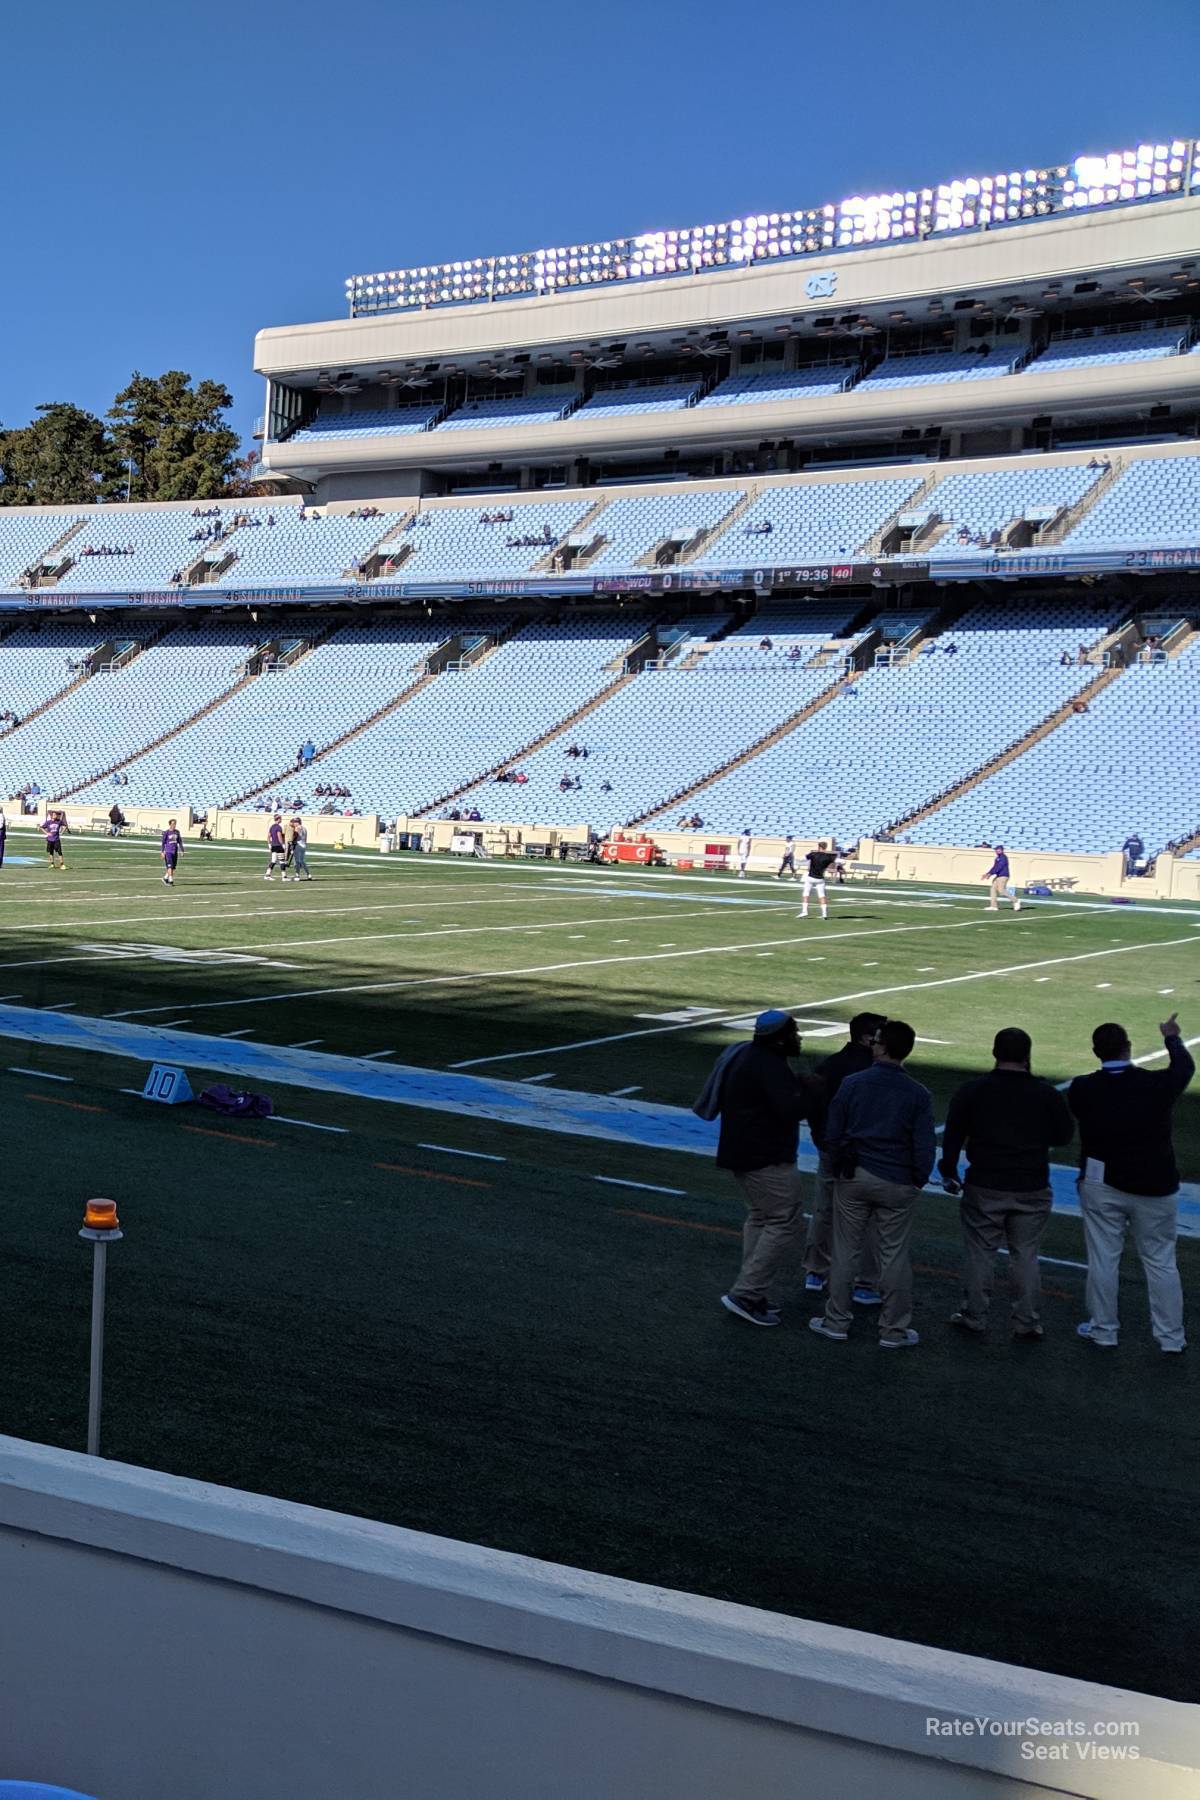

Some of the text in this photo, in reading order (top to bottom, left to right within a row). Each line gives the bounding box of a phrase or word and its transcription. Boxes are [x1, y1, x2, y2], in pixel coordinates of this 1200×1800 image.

[1125, 551, 1147, 567] 23
[753, 570, 764, 585] 0
[795, 568, 829, 582] 79:36
[835, 568, 849, 578] 40
[872, 567, 882, 577] &
[468, 580, 526, 595] 50 WEINER
[629, 577, 650, 588] WCU
[662, 574, 672, 589] 0
[362, 584, 406, 598] JUSTICE
[146, 1069, 176, 1099] 10
